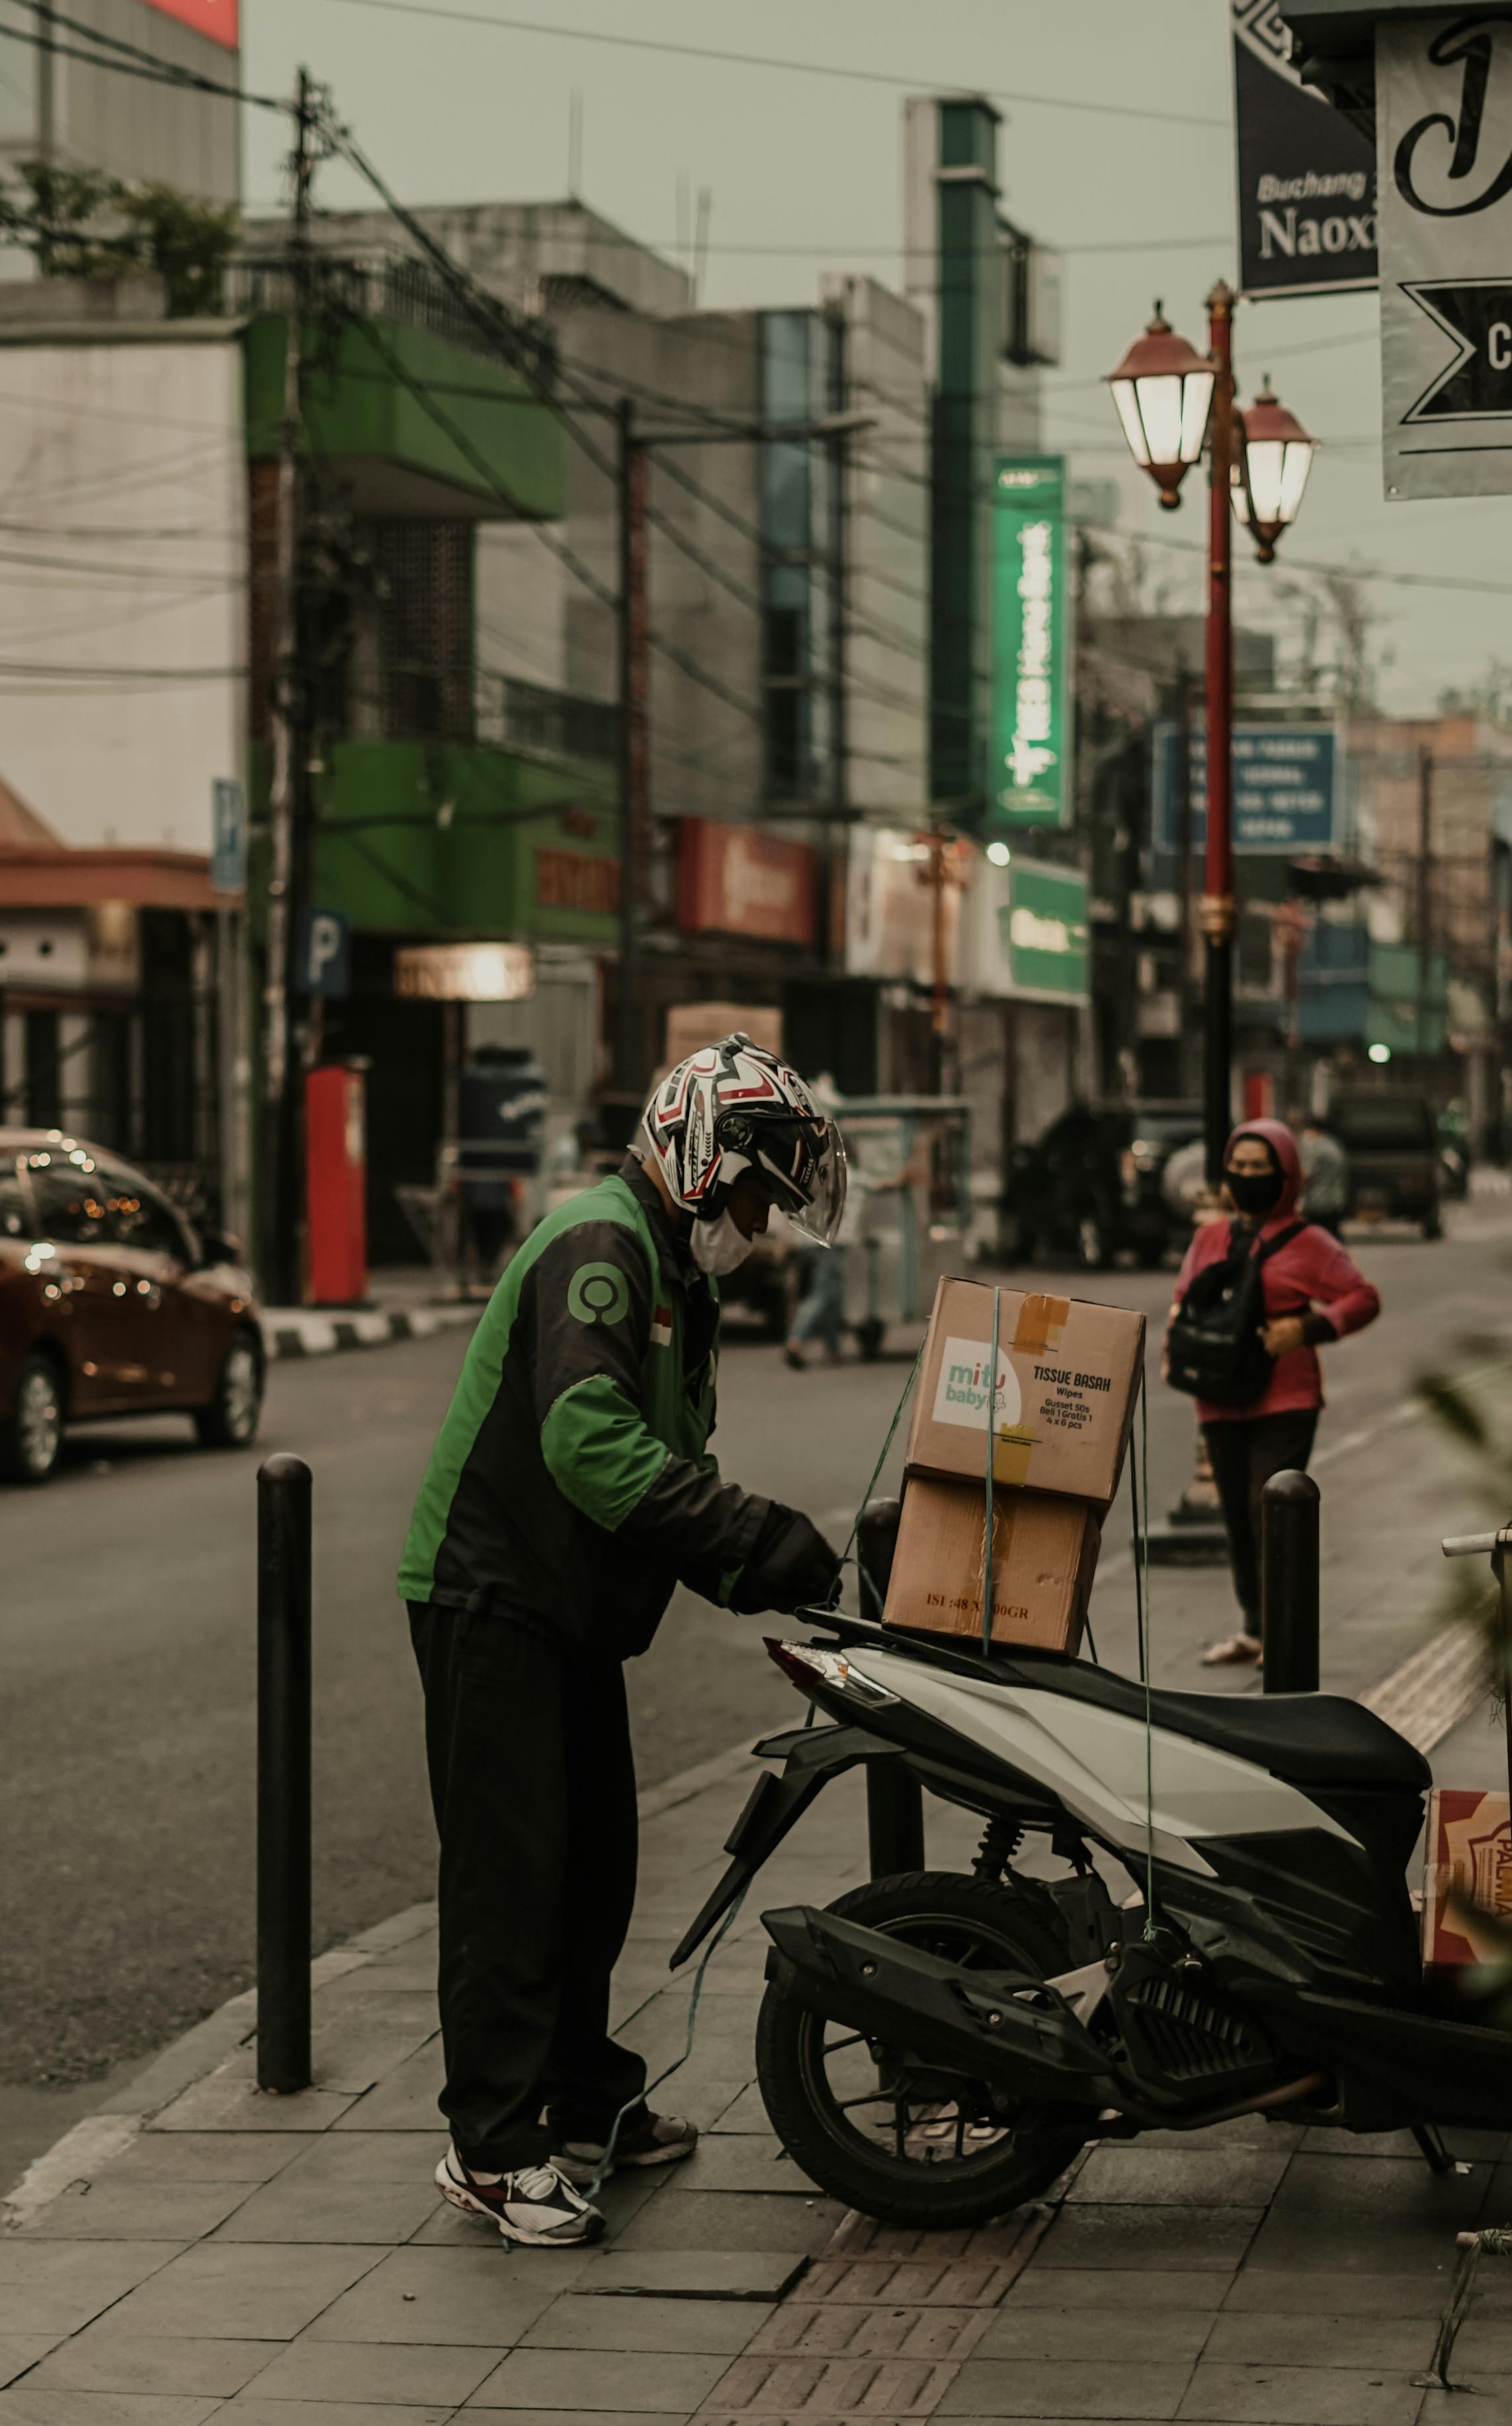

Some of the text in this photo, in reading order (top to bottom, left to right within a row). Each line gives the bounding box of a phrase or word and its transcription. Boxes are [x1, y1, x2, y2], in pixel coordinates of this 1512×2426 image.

[1257, 170, 1366, 203] Buchang
[1258, 206, 1377, 259] Naox
[308, 916, 340, 983] P
[1034, 1365, 1111, 1392] TISSUE BASAH
[945, 1384, 987, 1411] baby
[1045, 1398, 1073, 1410] Gusset
[1056, 1387, 1083, 1400] Wipes
[1040, 1406, 1055, 1416] Beli
[1062, 1410, 1087, 1421] Gratis
[926, 1593, 945, 1607] ISI
